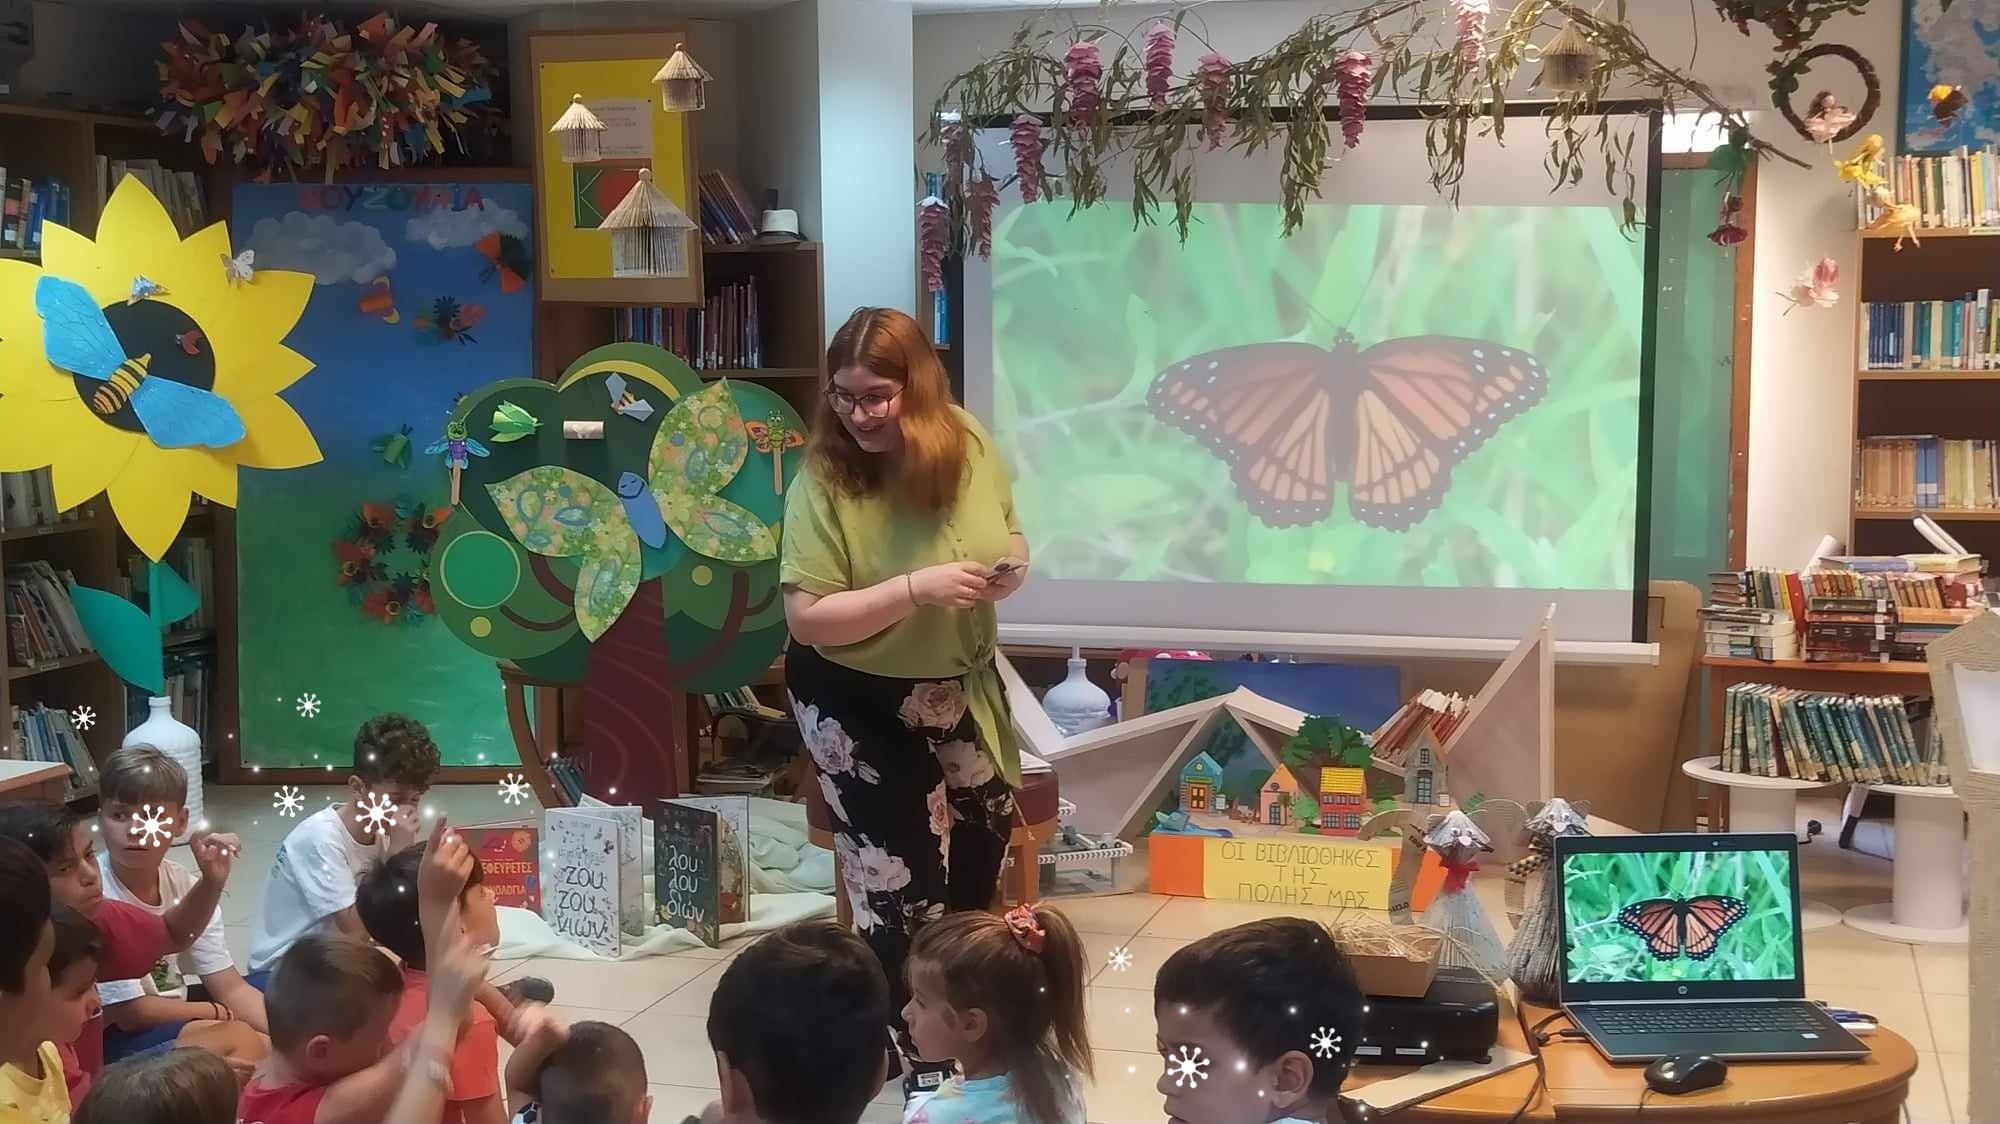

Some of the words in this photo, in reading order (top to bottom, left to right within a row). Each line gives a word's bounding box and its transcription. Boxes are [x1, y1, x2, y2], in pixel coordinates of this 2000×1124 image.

[1221, 841, 1246, 861] ΟΙ
[1255, 842, 1380, 868] ΒΙΒΛΙΟΘΗΚΕΣ
[1274, 865, 1327, 886] ΤΗΣ
[1327, 890, 1369, 909] ΜΑΣ
